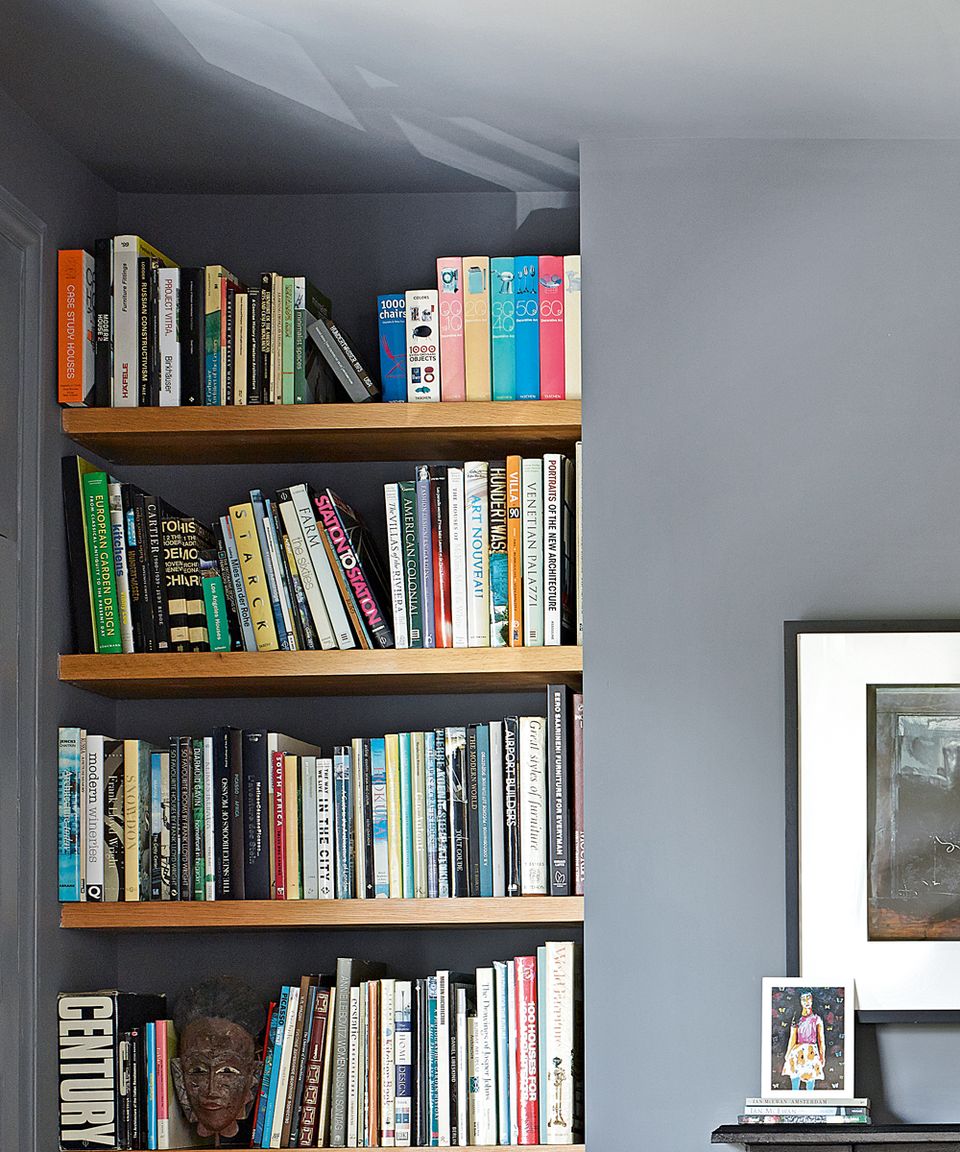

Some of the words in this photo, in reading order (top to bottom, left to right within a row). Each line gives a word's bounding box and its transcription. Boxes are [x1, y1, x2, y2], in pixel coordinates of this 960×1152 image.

[67, 284, 75, 309] CASE
[164, 278, 173, 312] PROJECT
[380, 299, 406, 308] 1000
[67, 311, 75, 340] STUDY
[379, 310, 407, 320] chairs
[67, 342, 75, 380] HOUSES
[164, 355, 173, 394] Birkhäuser
[409, 355, 437, 363] OBJECTS
[509, 471, 519, 503] VILLA
[548, 459, 558, 502] PORTRAITS
[95, 494, 107, 549] EUROPEAN
[314, 494, 350, 553] STATION
[403, 497, 415, 553] AMERICAN
[471, 494, 483, 522] ART
[526, 482, 539, 554] VENETIAN
[548, 503, 558, 514] OF
[548, 516, 558, 530] THE
[147, 504, 160, 554] CARTIER
[299, 506, 322, 549] FARM
[548, 532, 558, 551] NEW
[112, 523, 125, 577] kitchens
[341, 549, 357, 571] TO
[99, 551, 110, 594] GARDEN
[548, 553, 559, 612] ARCHITECTURE
[346, 565, 382, 627] STATION
[103, 597, 115, 637] DESIGN
[553, 692, 562, 712] EERO
[529, 720, 542, 749] Great
[504, 730, 516, 775] AIRPORT
[528, 754, 541, 781] styles
[88, 752, 99, 804] modern
[107, 775, 118, 803] Frank
[554, 755, 564, 797] FURNITURE
[125, 775, 138, 851] SNOWDON
[193, 785, 202, 807] GAVIN
[320, 798, 330, 812] IN
[505, 778, 517, 828] BUILDERS
[555, 799, 563, 813] FOR
[88, 805, 100, 864] wineries
[319, 817, 330, 845] THE
[527, 800, 542, 851] furniture
[555, 815, 564, 855] EVERYMAN
[319, 849, 330, 882] CITY
[277, 992, 289, 1025] PICASSO
[527, 1001, 537, 1023] 100
[527, 1024, 538, 1075] HOUSES
[58, 996, 116, 1147] CENTURY
[399, 1066, 408, 1097] DESIGN
[528, 1076, 538, 1102] FOR
